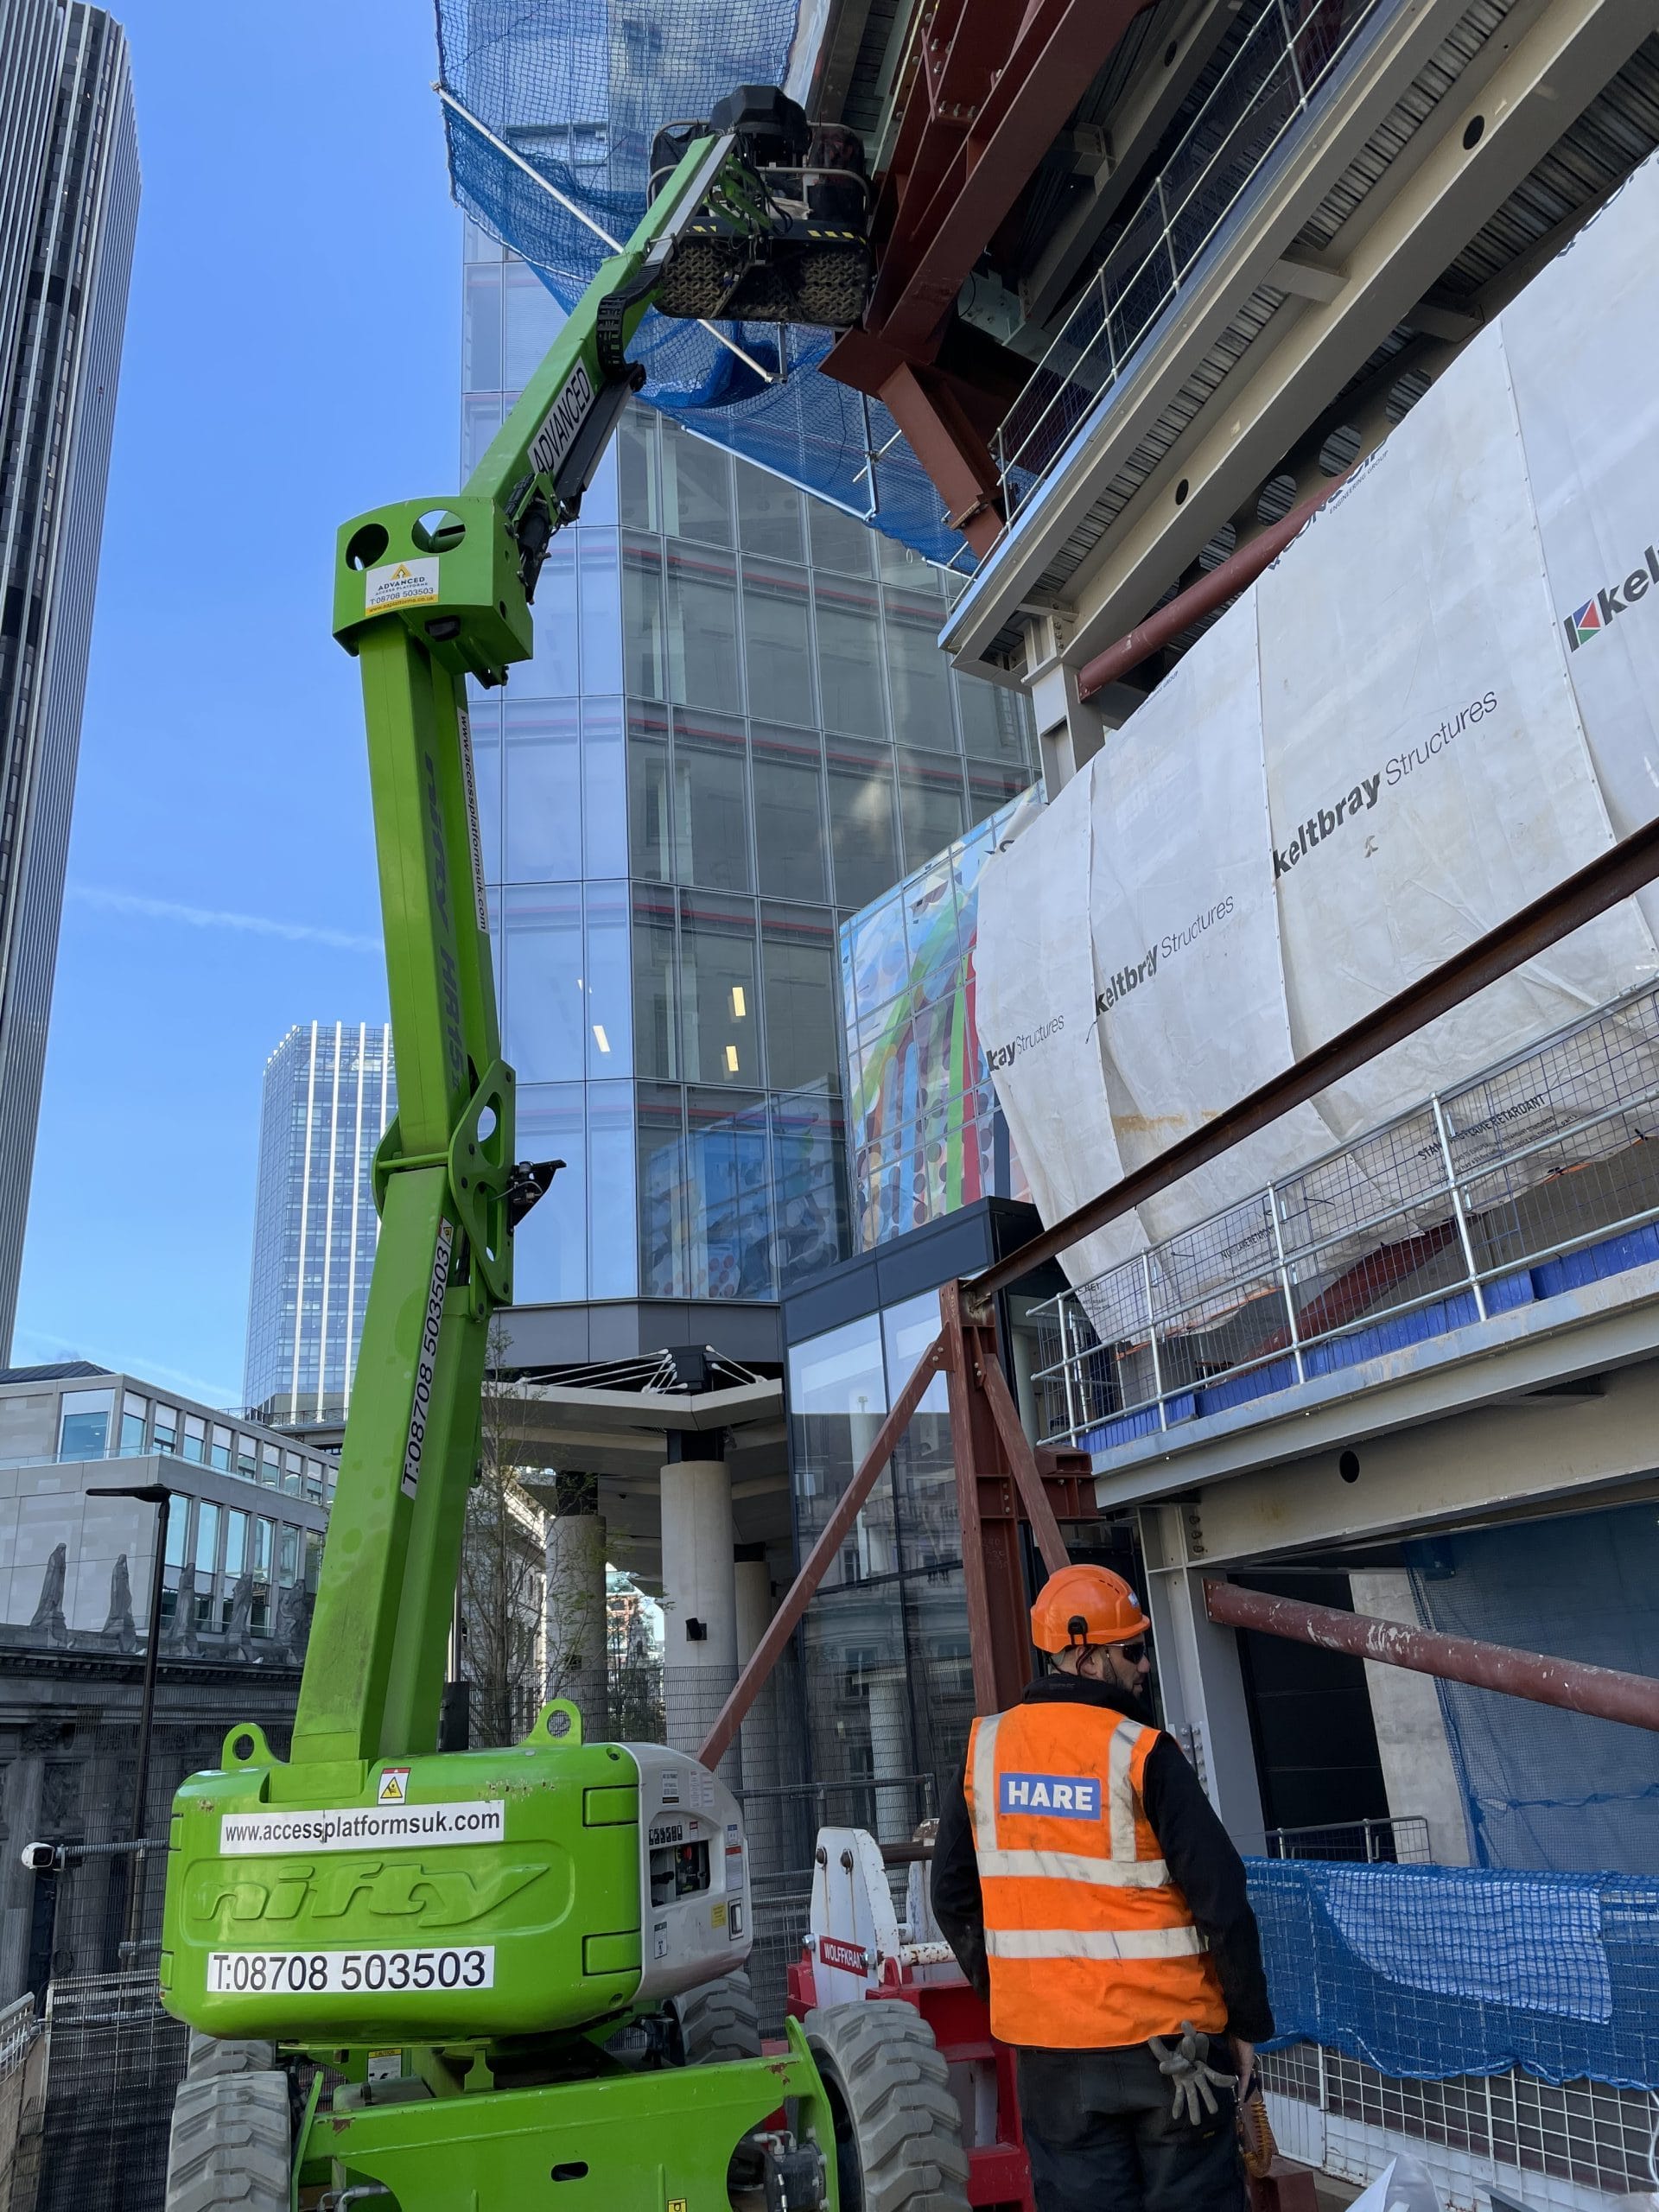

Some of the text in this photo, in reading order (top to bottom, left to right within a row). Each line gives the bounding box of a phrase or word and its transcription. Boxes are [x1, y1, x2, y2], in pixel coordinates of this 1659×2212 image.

[532, 367, 591, 474] ADVANCED
[378, 576, 425, 591] ADVANCED
[402, 587, 435, 598] 503503
[1597, 544, 1659, 626] kel
[1273, 690, 1497, 880] keltbray Structures
[460, 715, 487, 931] www.accessplatformsuk.com
[1096, 895, 1234, 1017] keltbray Structures
[1016, 1014, 1065, 1056] Structures
[1491, 1093, 1546, 1131] RETARDANT
[402, 1246, 450, 1488] T:08708 503503
[1007, 1780, 1094, 1812] HARE
[226, 1810, 501, 1843] www.accessplatformsuk.com
[191, 1860, 550, 1928] nifty
[213, 1949, 486, 1991] T:08708 503503
